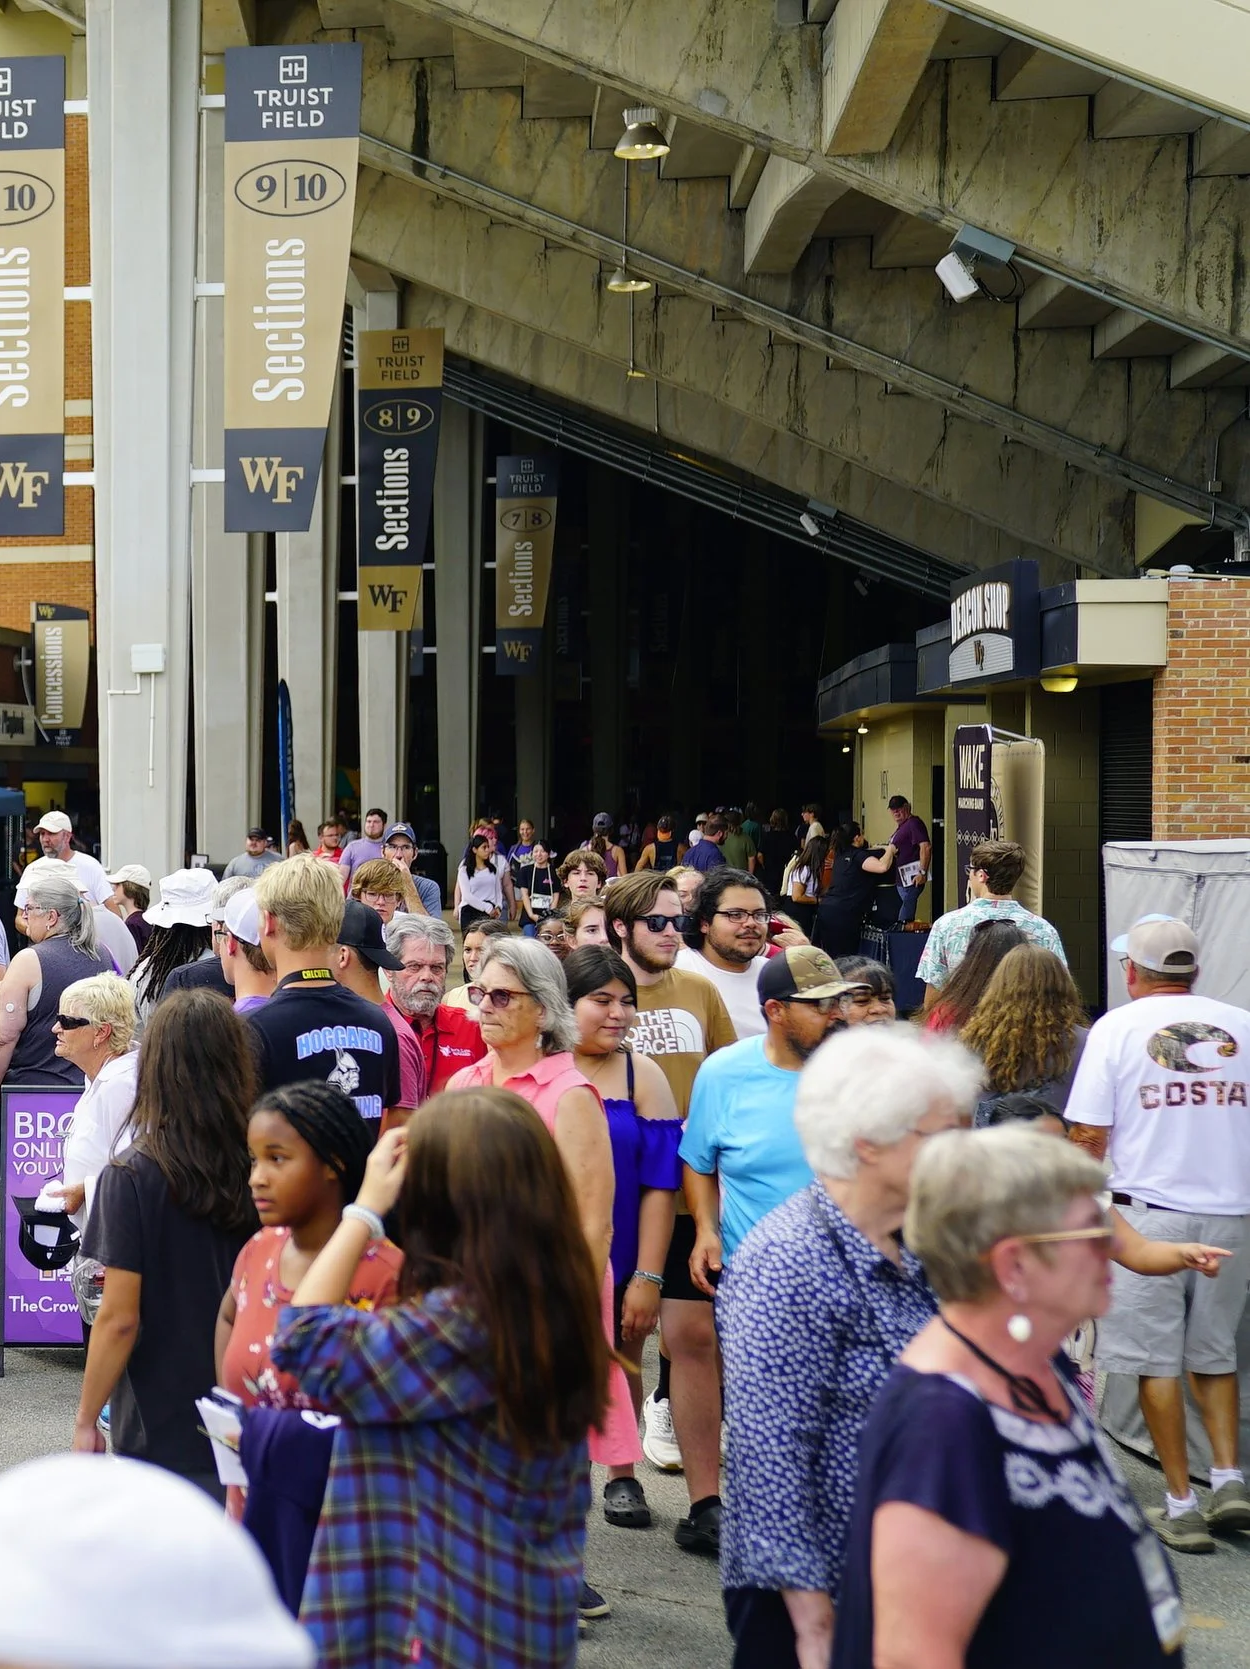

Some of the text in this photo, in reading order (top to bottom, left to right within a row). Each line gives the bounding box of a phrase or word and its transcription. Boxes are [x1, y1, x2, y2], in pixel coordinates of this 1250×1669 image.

[254, 87, 333, 107] TRUIST
[262, 110, 325, 129] FIELD
[251, 237, 306, 402] Sections
[376, 355, 425, 368] TRUIST
[381, 368, 420, 381] FIELD
[239, 456, 304, 503] WF
[509, 473, 546, 485] TRUIST
[512, 483, 542, 493] FIELD
[375, 447, 409, 551] Sections
[509, 541, 533, 617] Sections
[368, 584, 408, 613] WF
[951, 582, 1010, 646] DEACON SHOP
[503, 640, 532, 663] WF
[40, 627, 63, 724] Concessions
[959, 744, 985, 790] WAKE
[635, 1009, 672, 1025] THE
[296, 1025, 383, 1060] HOGGARD
[624, 1023, 676, 1042] ORTH
[631, 1038, 678, 1055] FACE
[1140, 1081, 1248, 1110] COSTA
[12, 1161, 48, 1175] YOU
